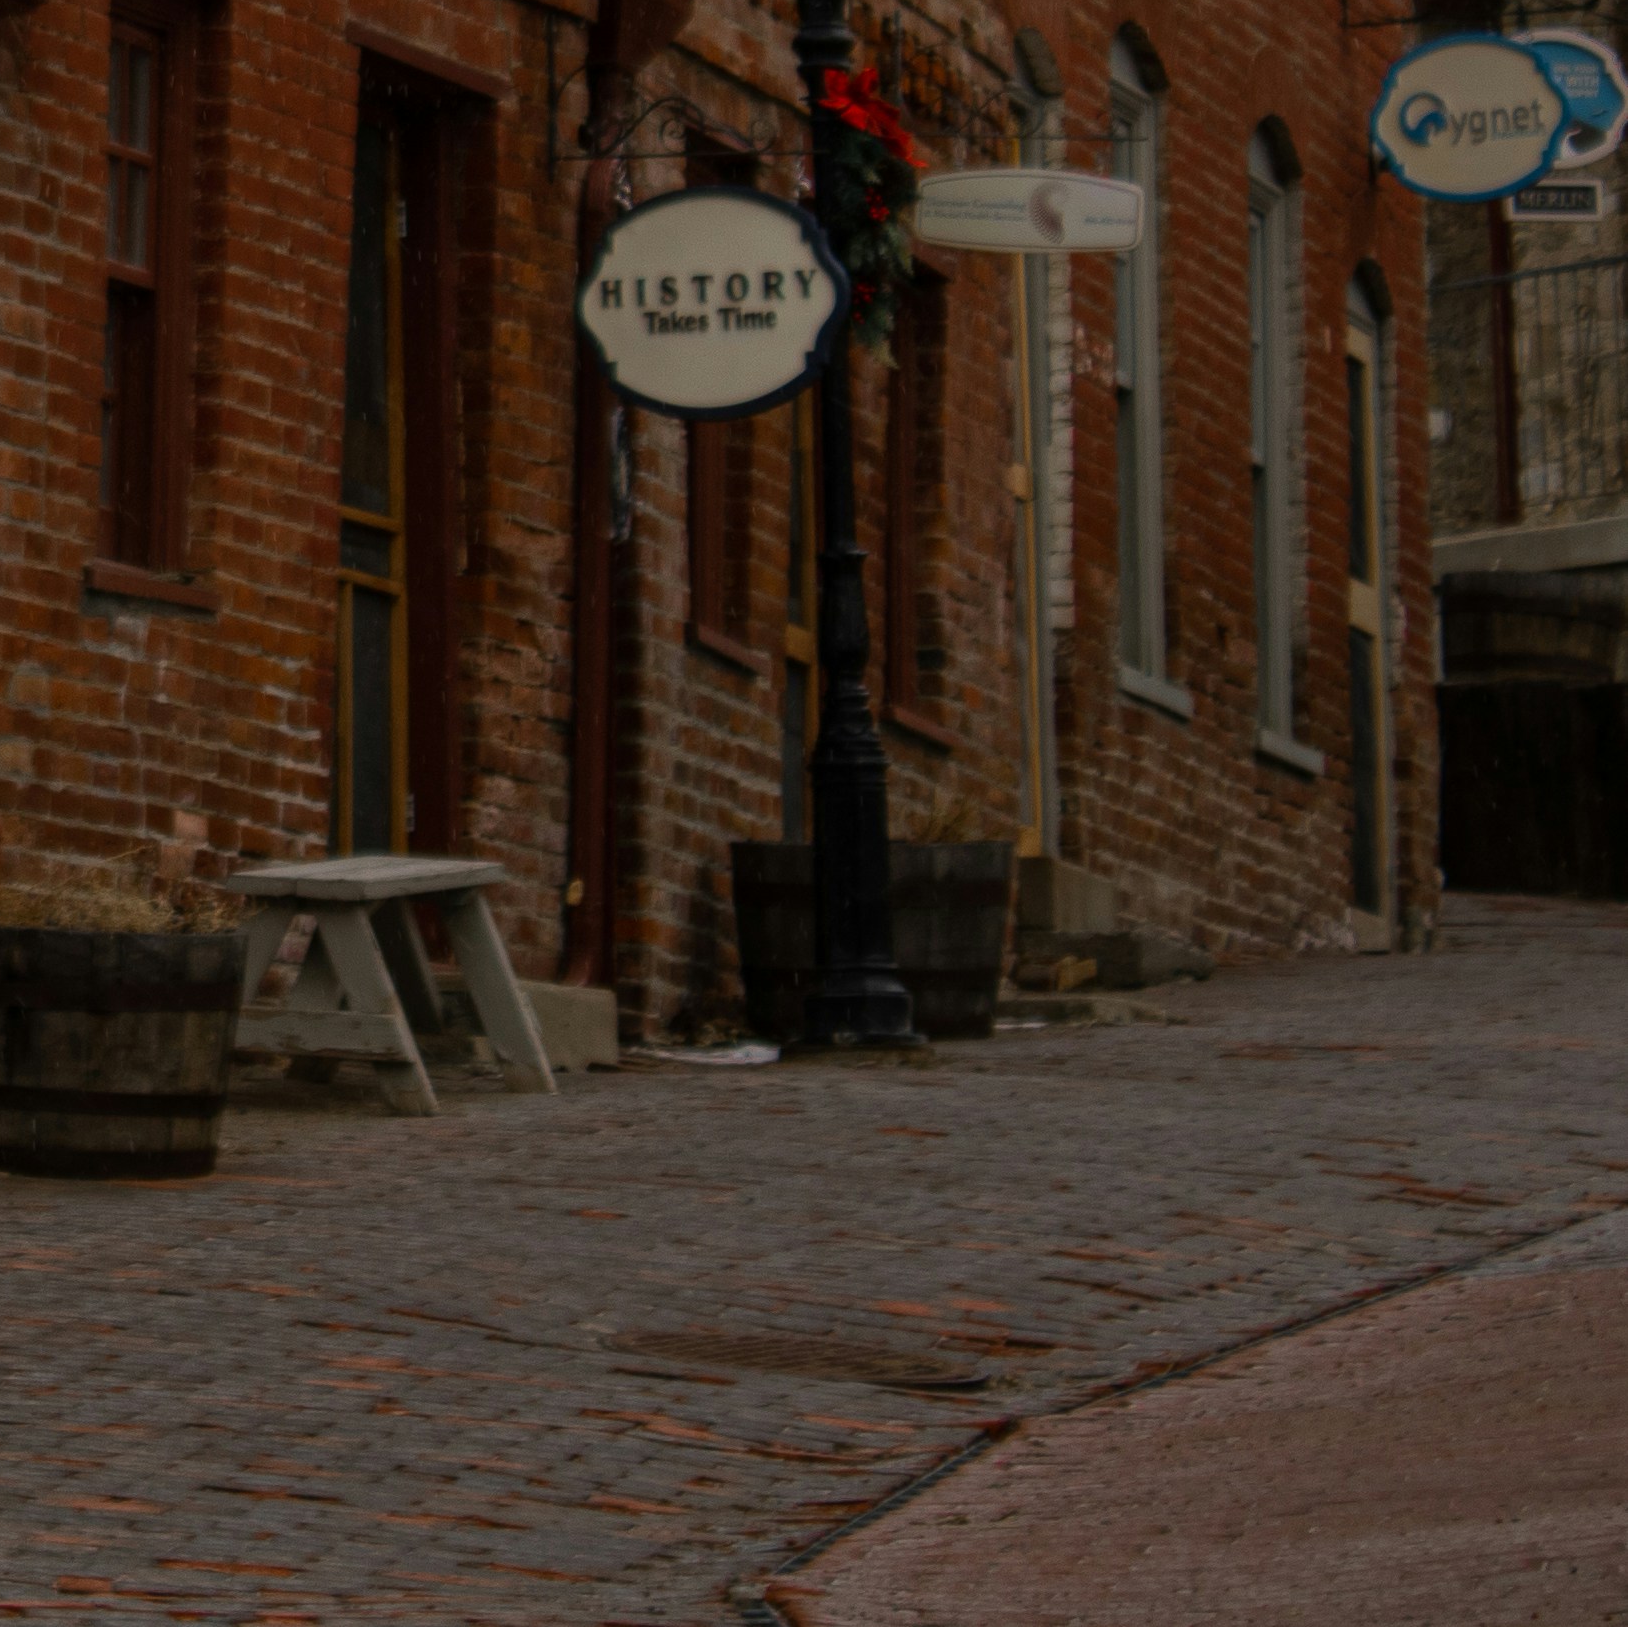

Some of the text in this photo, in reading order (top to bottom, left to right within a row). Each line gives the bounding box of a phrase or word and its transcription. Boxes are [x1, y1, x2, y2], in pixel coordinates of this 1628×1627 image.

[600, 269, 819, 309] HISTORY
[642, 306, 777, 336] Takes Time
